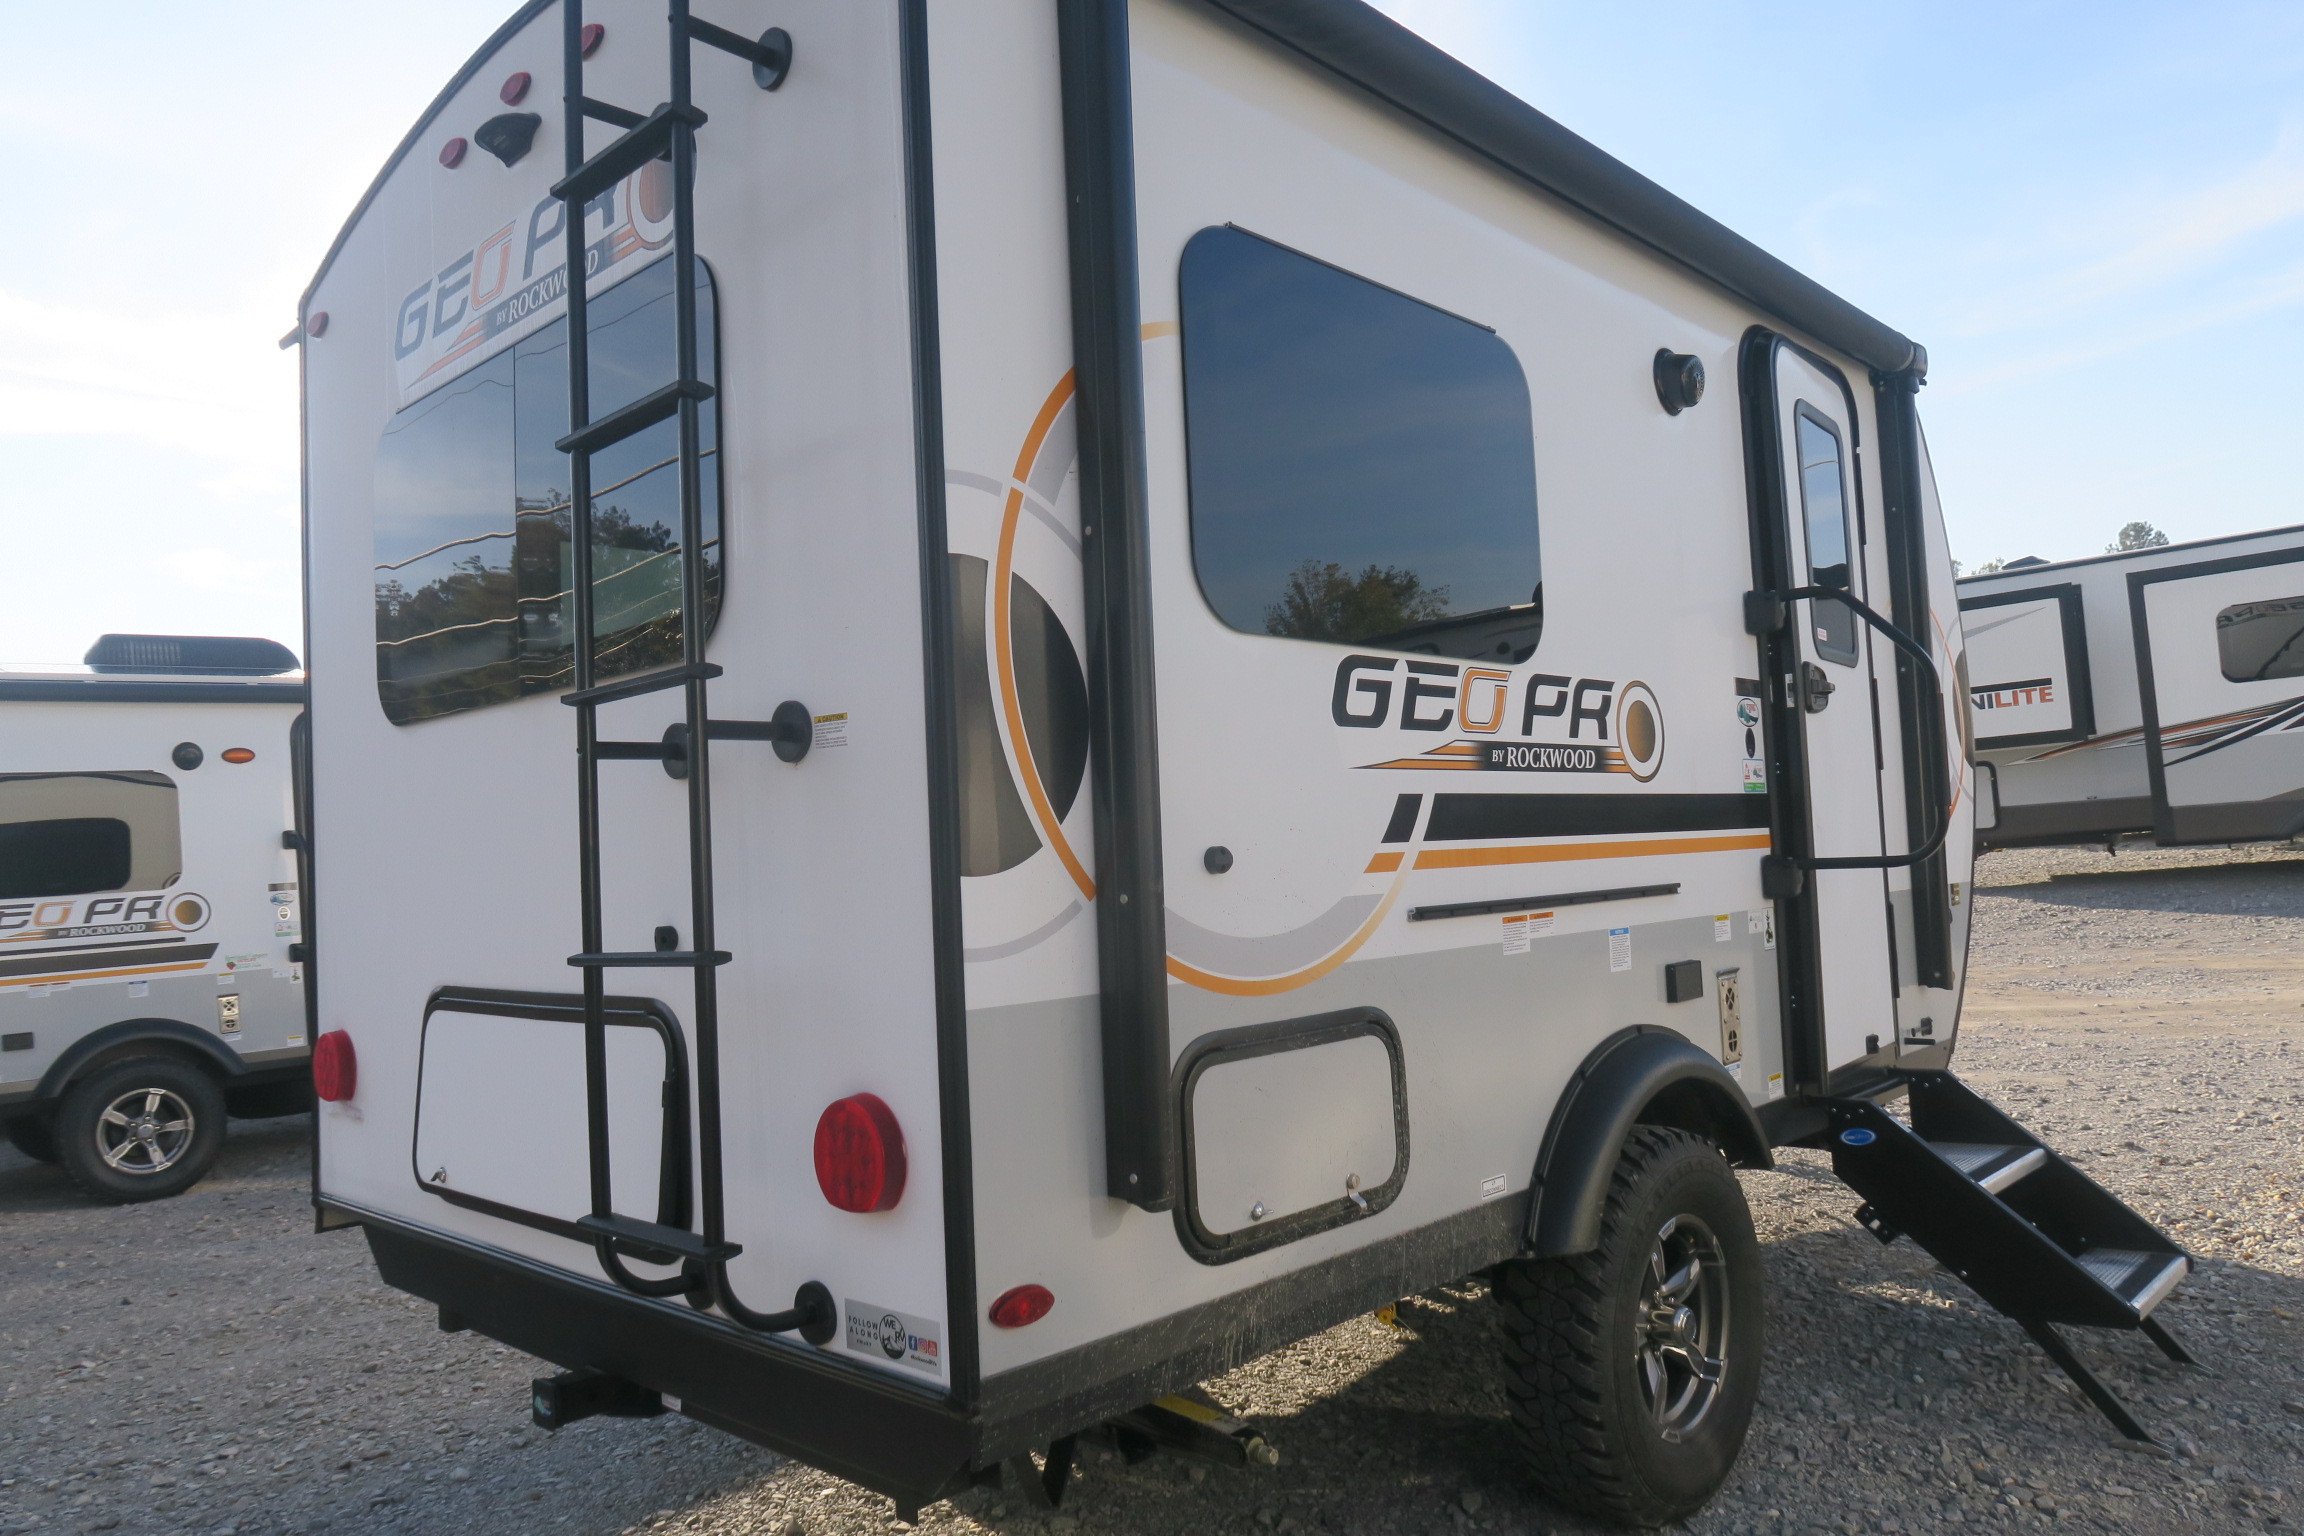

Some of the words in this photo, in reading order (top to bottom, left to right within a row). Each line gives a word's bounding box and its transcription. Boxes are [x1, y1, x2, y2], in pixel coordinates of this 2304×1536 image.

[395, 219, 516, 361] GEO
[508, 249, 599, 323] ROCKWD
[1331, 654, 1512, 734] GEO
[1521, 672, 1665, 783] PRO
[1492, 749, 1505, 762] BY
[1506, 746, 1596, 769] ROCKWOOD
[83, 891, 212, 933] PRO
[69, 923, 146, 937] ROCKWOOD
[848, 1315, 878, 1330] FOLLOW
[849, 1326, 878, 1341] ALONG
[883, 1319, 896, 1330] WE
